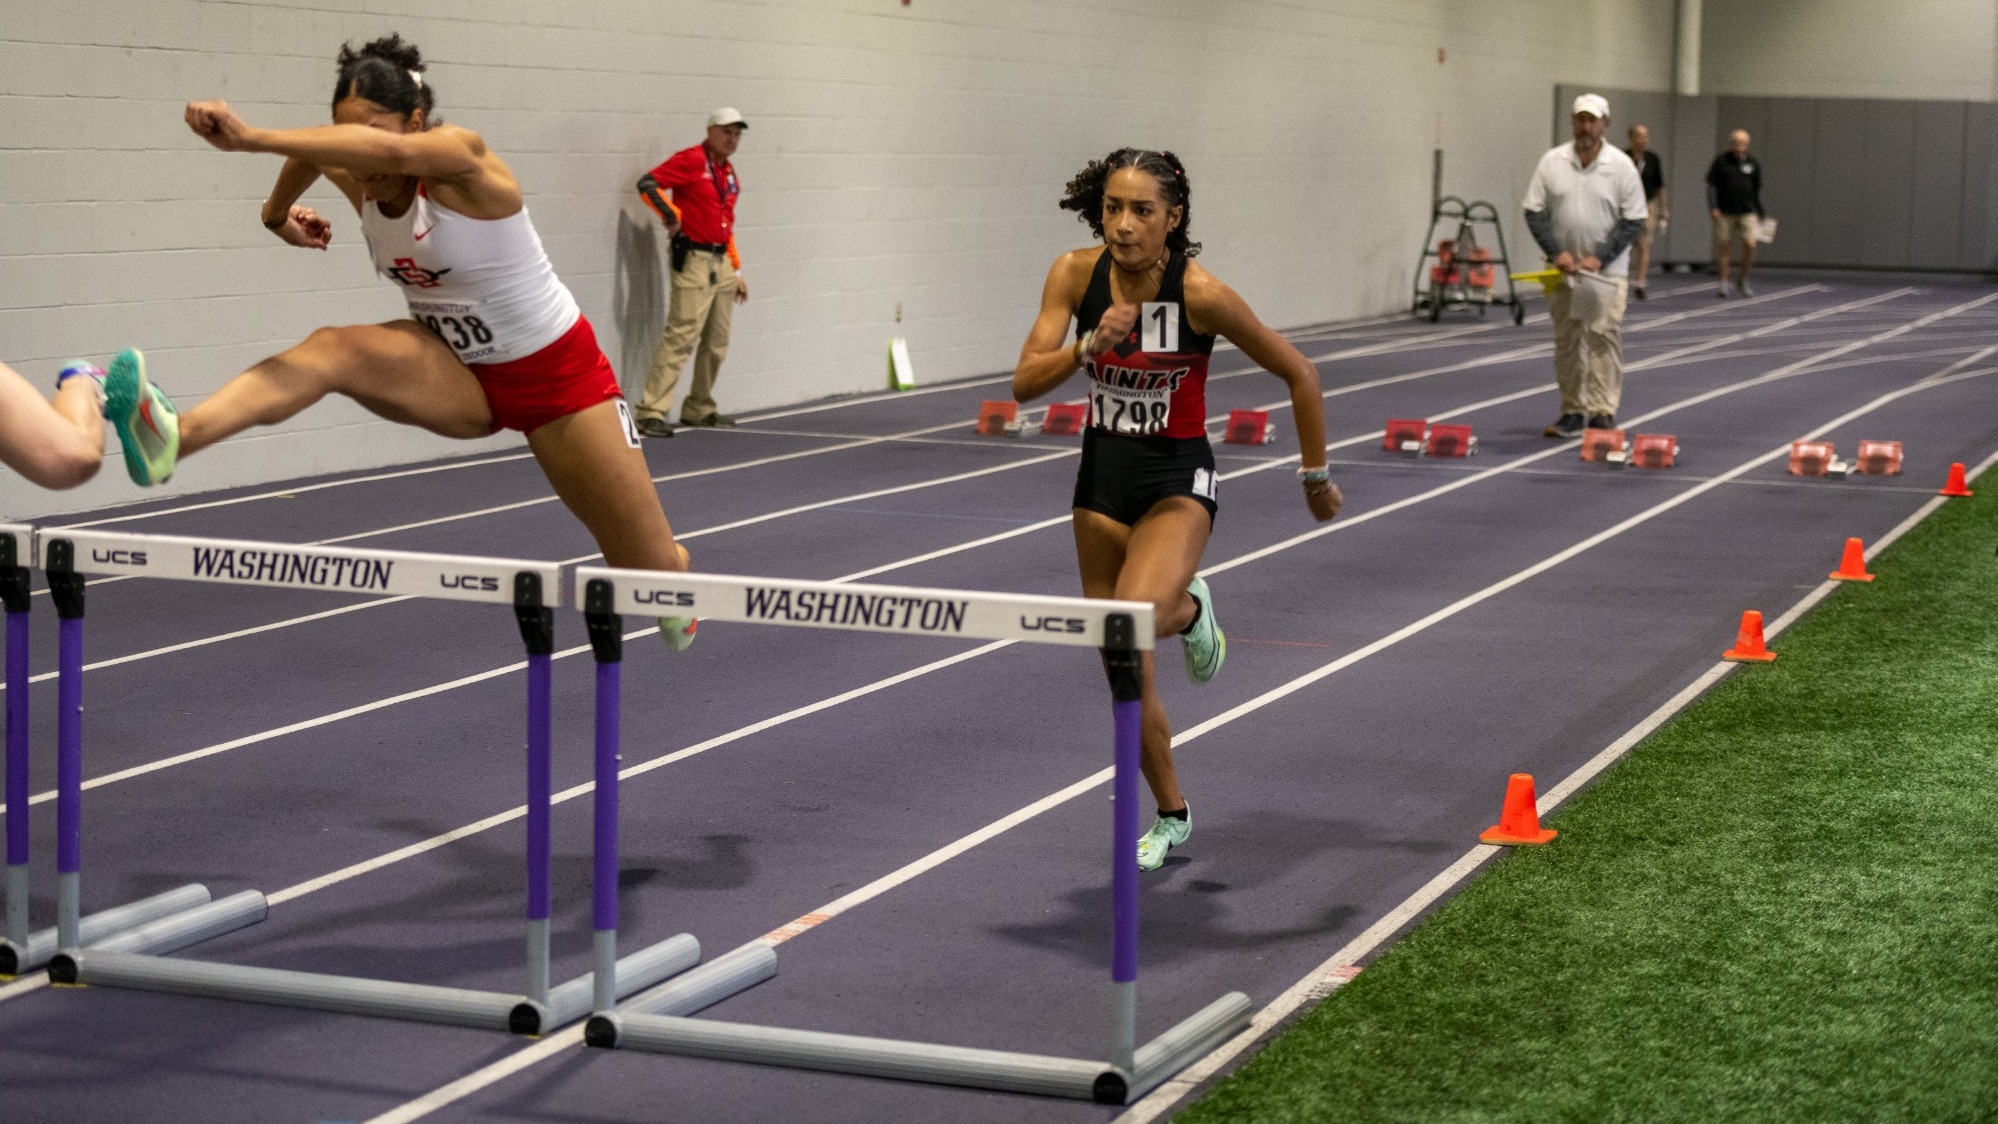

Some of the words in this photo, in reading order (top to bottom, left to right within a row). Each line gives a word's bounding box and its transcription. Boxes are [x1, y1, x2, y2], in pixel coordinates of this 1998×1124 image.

[1151, 305, 1167, 348] 1
[1085, 361, 1190, 392] AINTS
[619, 402, 640, 445] 2
[1094, 394, 1167, 435] 1798
[92, 548, 148, 566] UCS
[192, 546, 394, 590] WASHINGTON
[440, 572, 499, 592] UCS
[633, 588, 695, 607] UCS
[744, 586, 969, 632] WASHINGTON
[1019, 614, 1087, 634] UCS
